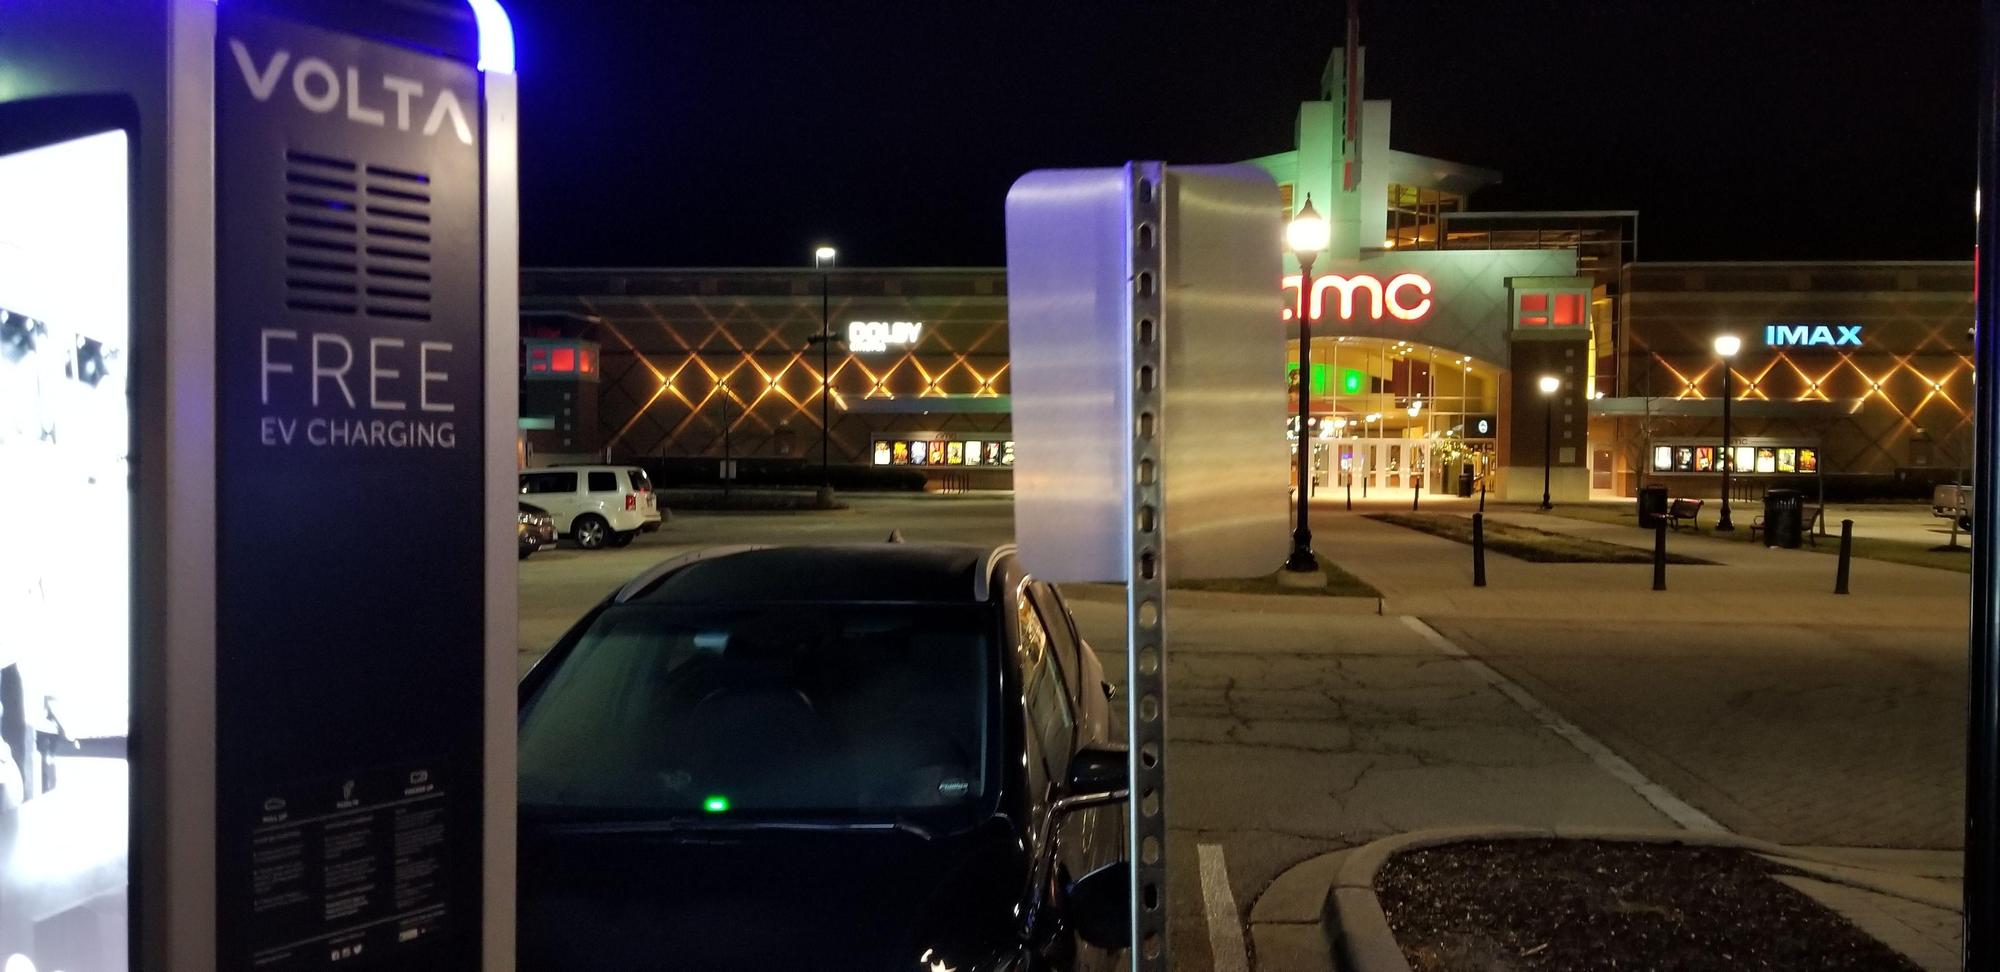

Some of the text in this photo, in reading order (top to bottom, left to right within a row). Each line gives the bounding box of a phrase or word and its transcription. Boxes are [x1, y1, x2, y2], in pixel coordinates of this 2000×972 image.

[229, 37, 473, 146] VOLTA
[1766, 325, 1863, 346] IMAX
[261, 328, 455, 412] FREE
[261, 416, 456, 449] EV CHARGING
